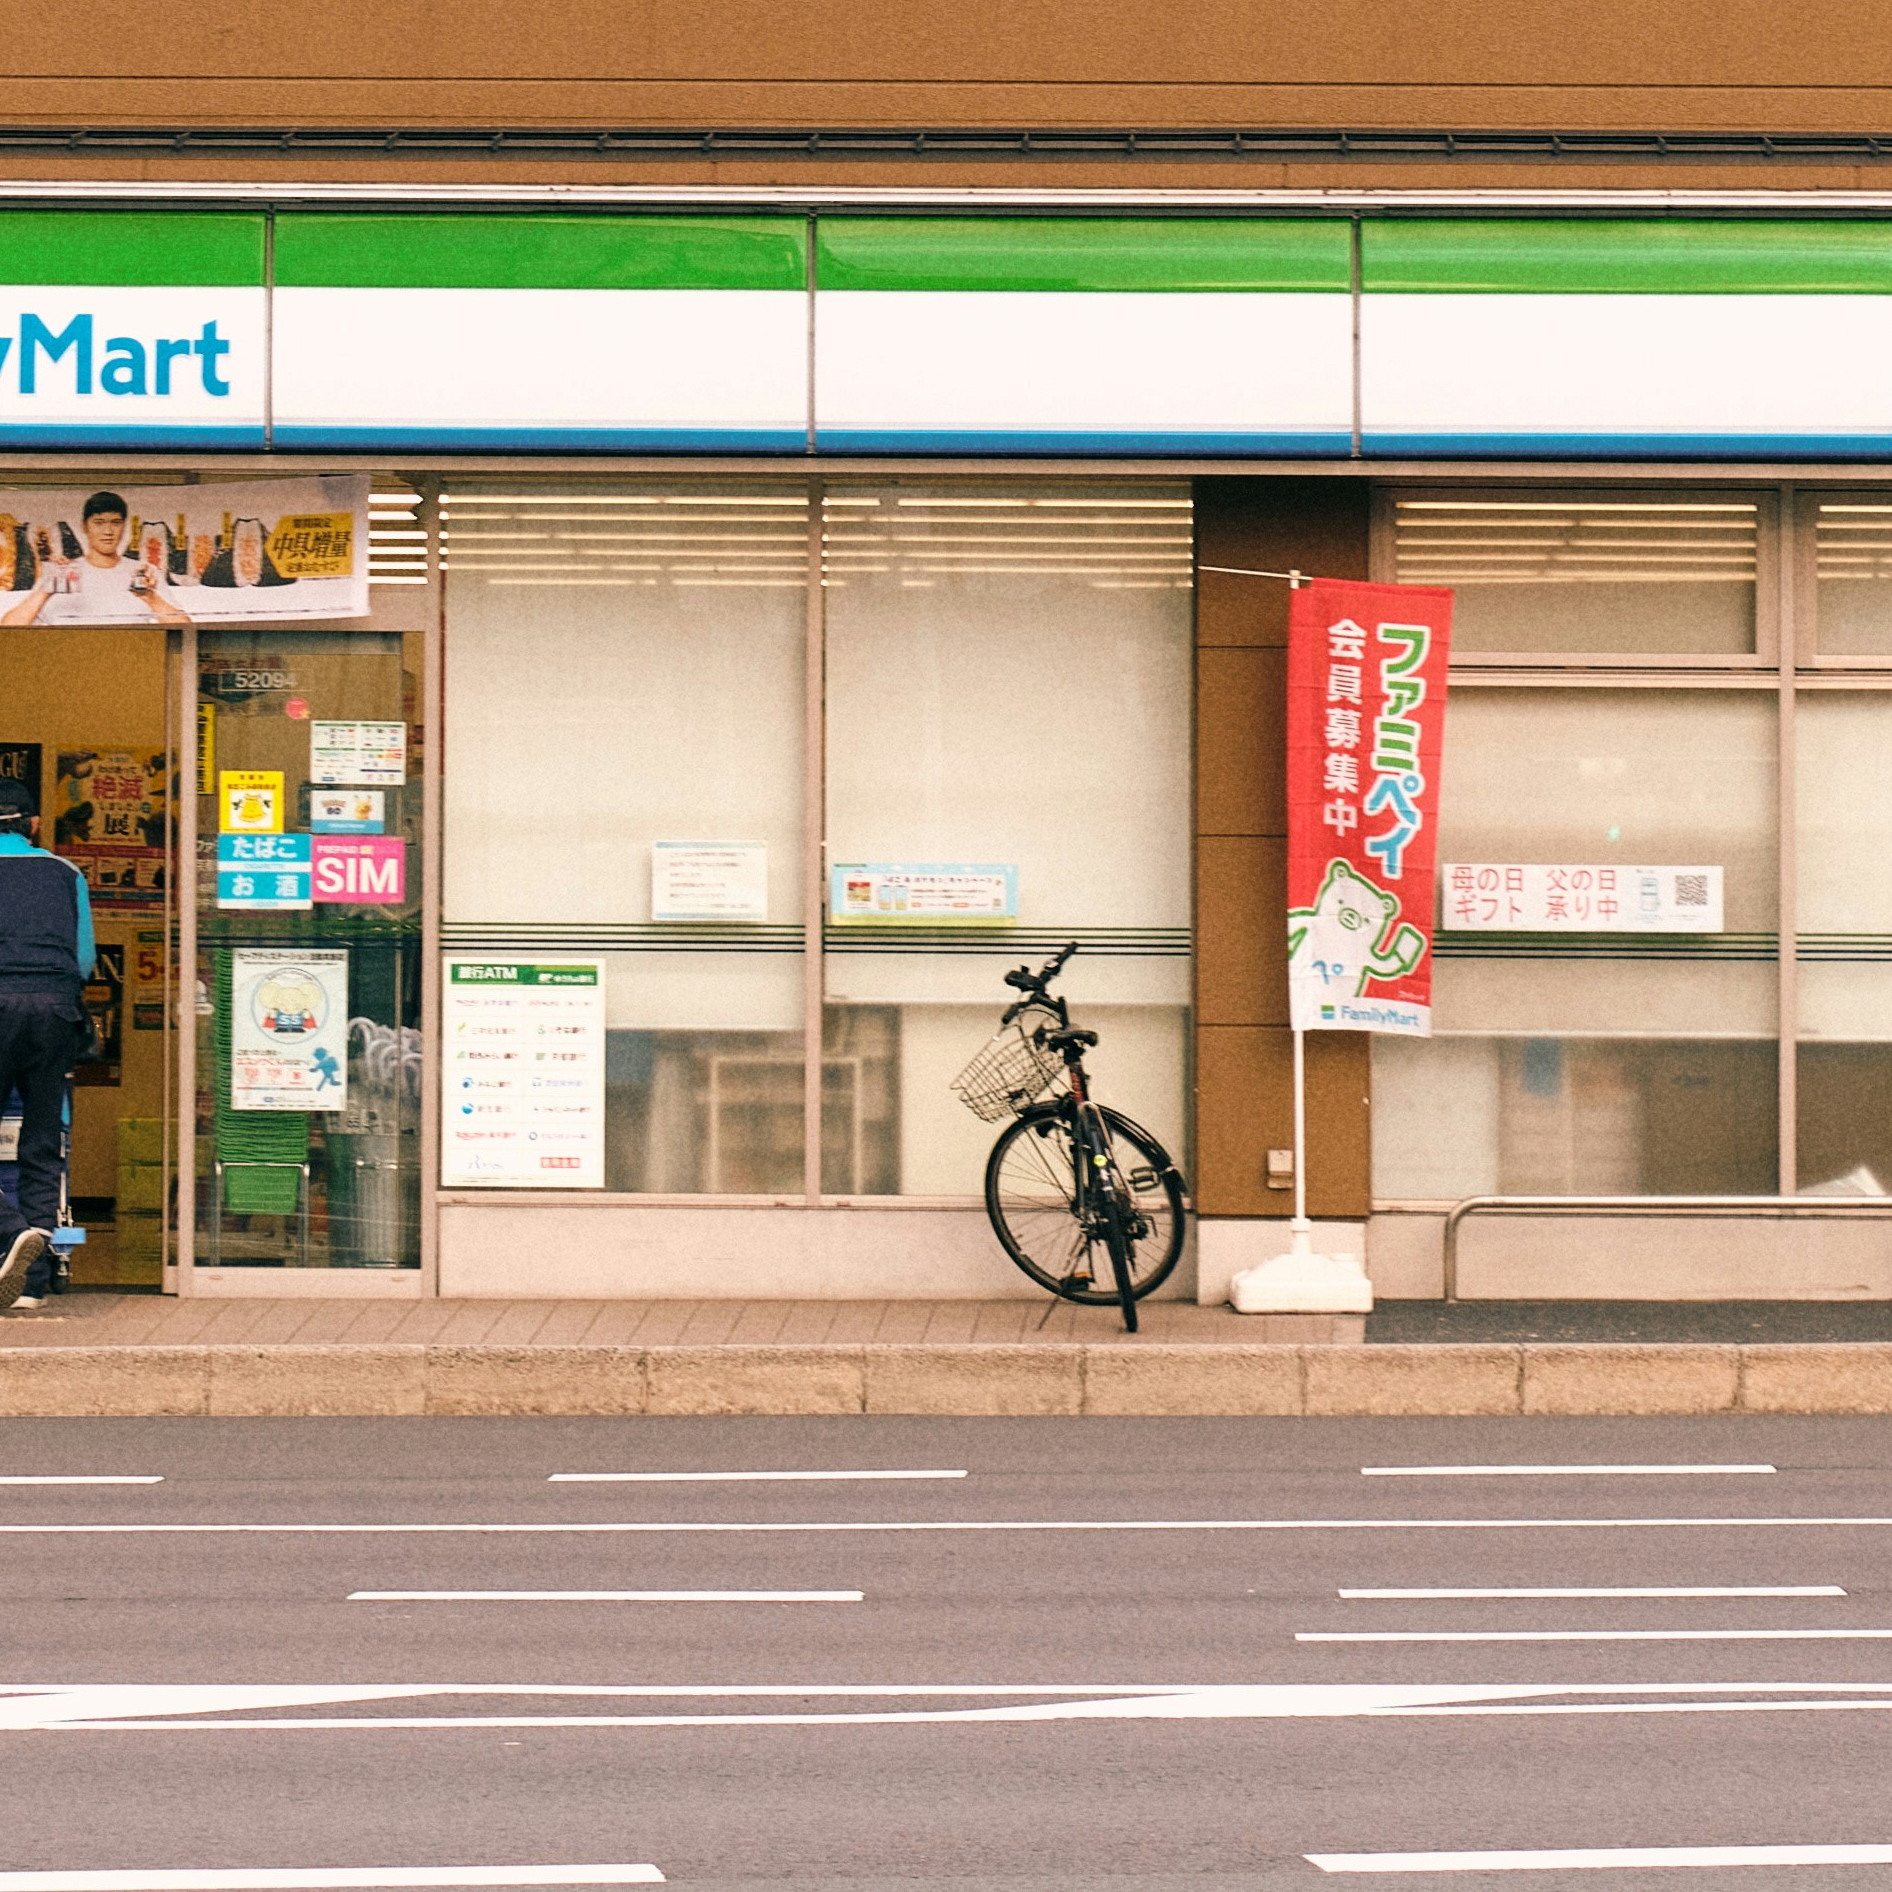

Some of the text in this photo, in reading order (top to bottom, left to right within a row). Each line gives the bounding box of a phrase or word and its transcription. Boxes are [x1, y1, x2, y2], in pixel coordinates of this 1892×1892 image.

[234, 672, 297, 688] 52094
[1322, 618, 1368, 837] 会員募集中
[1364, 623, 1431, 879] ファミペイ
[232, 837, 298, 859] たばこ
[316, 857, 398, 894] SIM
[1451, 866, 1617, 893] 母の日 父の日
[1454, 894, 1522, 922] ギフト
[1545, 895, 1619, 922] 承り中
[1341, 1005, 1420, 1027] FamilyMart
